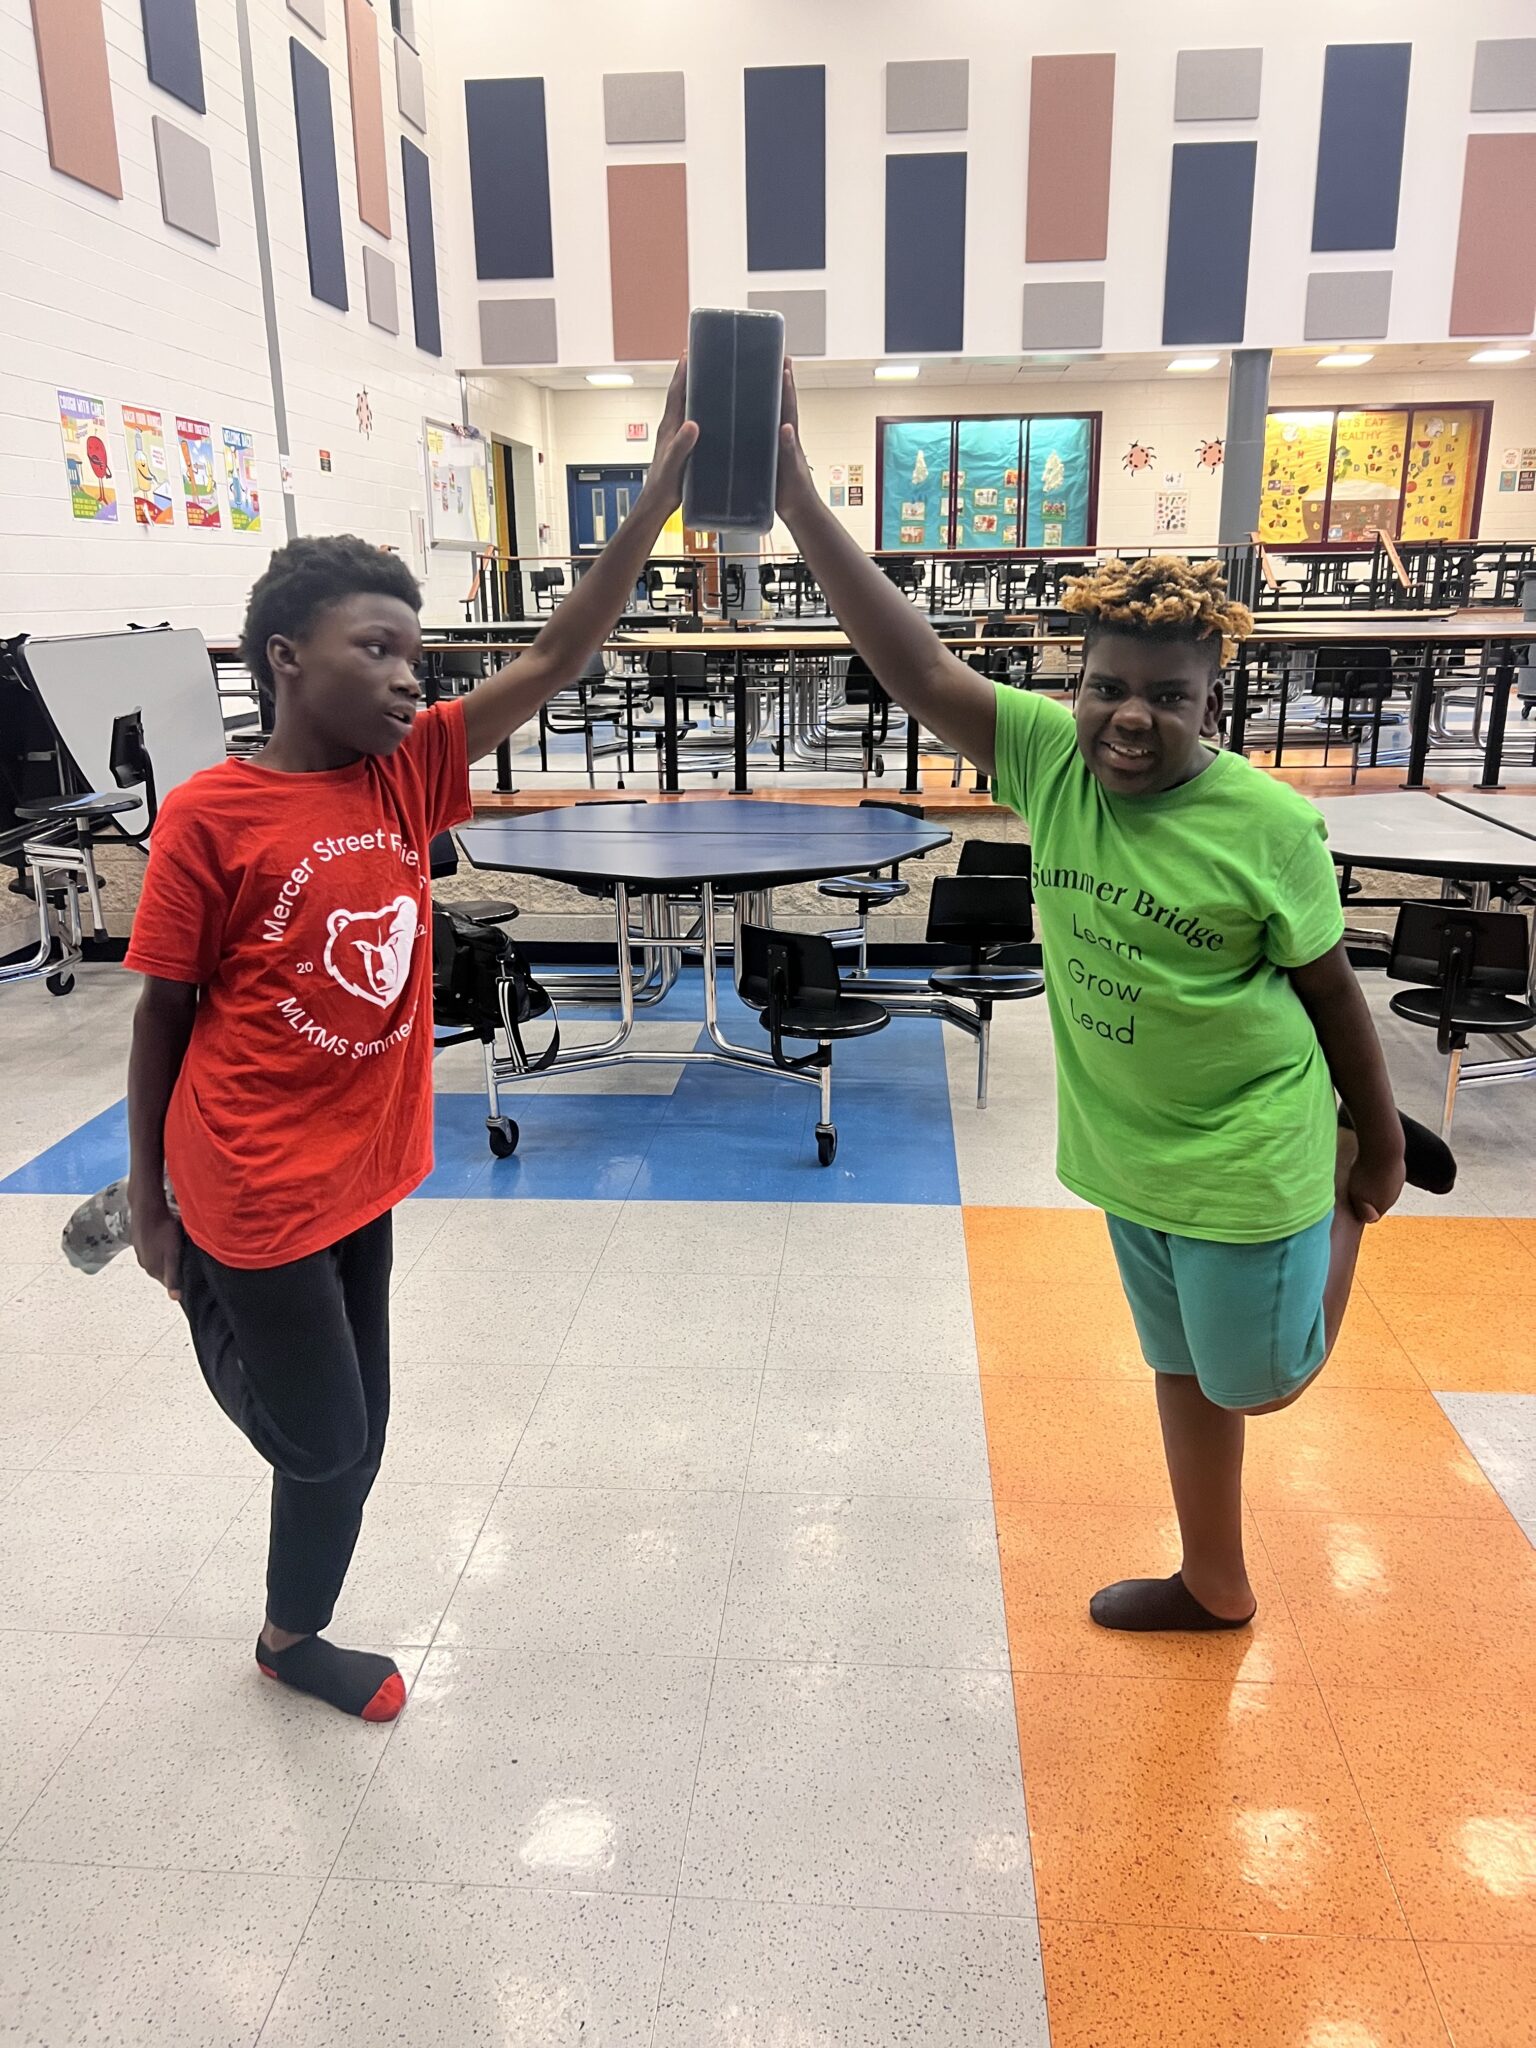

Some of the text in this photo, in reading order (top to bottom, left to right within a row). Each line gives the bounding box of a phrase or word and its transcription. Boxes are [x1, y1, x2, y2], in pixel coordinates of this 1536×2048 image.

[263, 857, 314, 942] Mercer
[313, 828, 386, 862] Street
[1032, 862, 1224, 952] Summer Bridge
[1072, 913, 1142, 960] Learn
[296, 961, 314, 974] 20
[1067, 958, 1142, 1003] Grow
[276, 997, 349, 1056] MLKMS
[1070, 998, 1134, 1045] Lead
